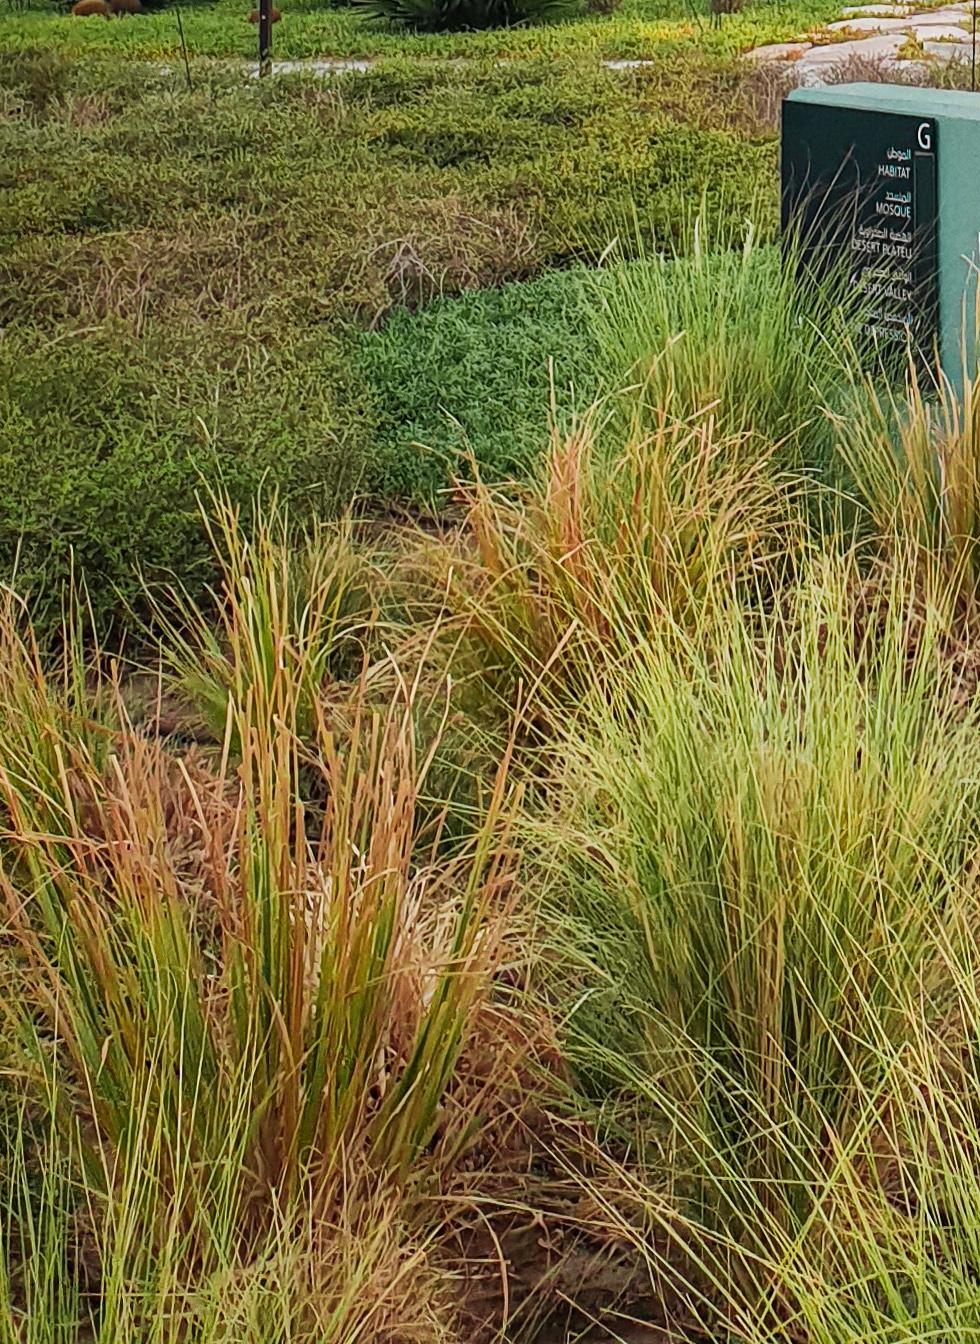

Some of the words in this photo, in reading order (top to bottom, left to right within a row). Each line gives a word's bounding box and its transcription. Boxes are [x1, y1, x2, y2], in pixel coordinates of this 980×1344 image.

[917, 123, 931, 150] G
[878, 164, 911, 180] HABITAT
[876, 201, 912, 219] MOSQUE
[852, 239, 881, 254] DESERT
[852, 279, 882, 296] DSERT
